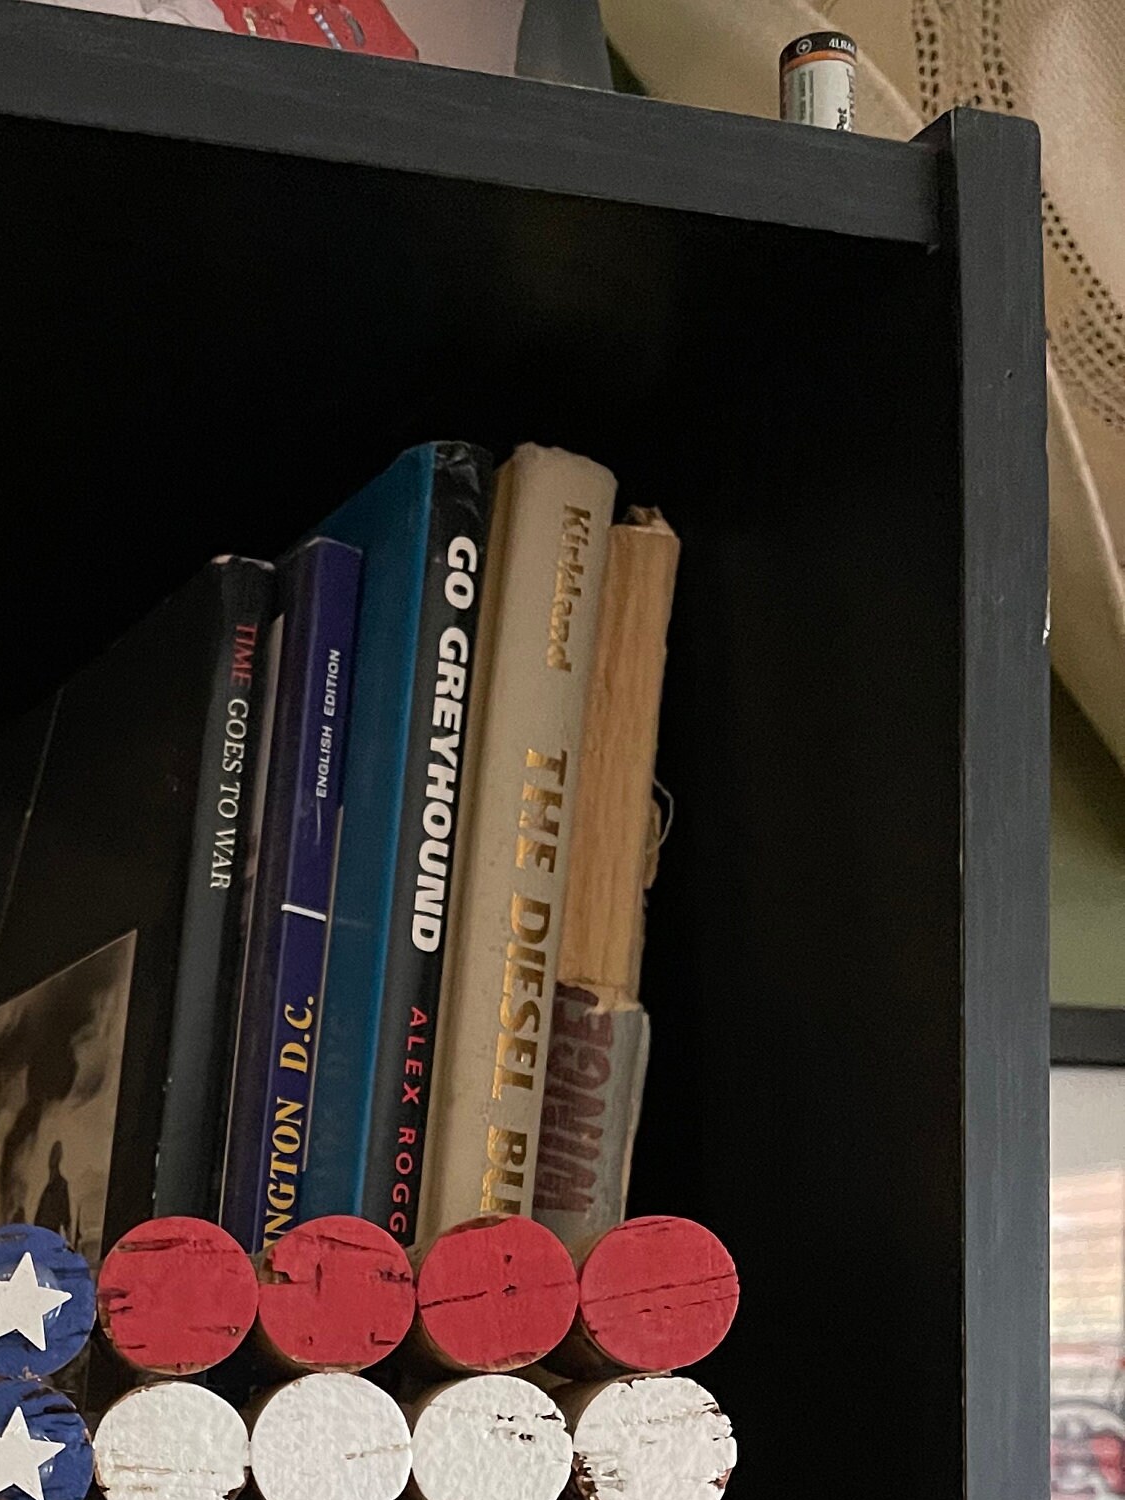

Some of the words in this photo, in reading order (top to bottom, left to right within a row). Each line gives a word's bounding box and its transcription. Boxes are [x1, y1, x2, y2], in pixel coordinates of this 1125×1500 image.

[443, 535, 477, 611] GO
[230, 623, 257, 688] TIME
[323, 648, 341, 717] EDITION
[222, 698, 249, 774] GOES
[315, 724, 334, 799] ENGLISH
[217, 782, 242, 819] TO
[411, 626, 470, 954] GREYHOUND
[514, 747, 568, 874] THE
[210, 827, 236, 890] WAR
[492, 891, 551, 1100] DIESEL
[279, 995, 315, 1074] D.C.
[400, 1006, 428, 1105] ALEX
